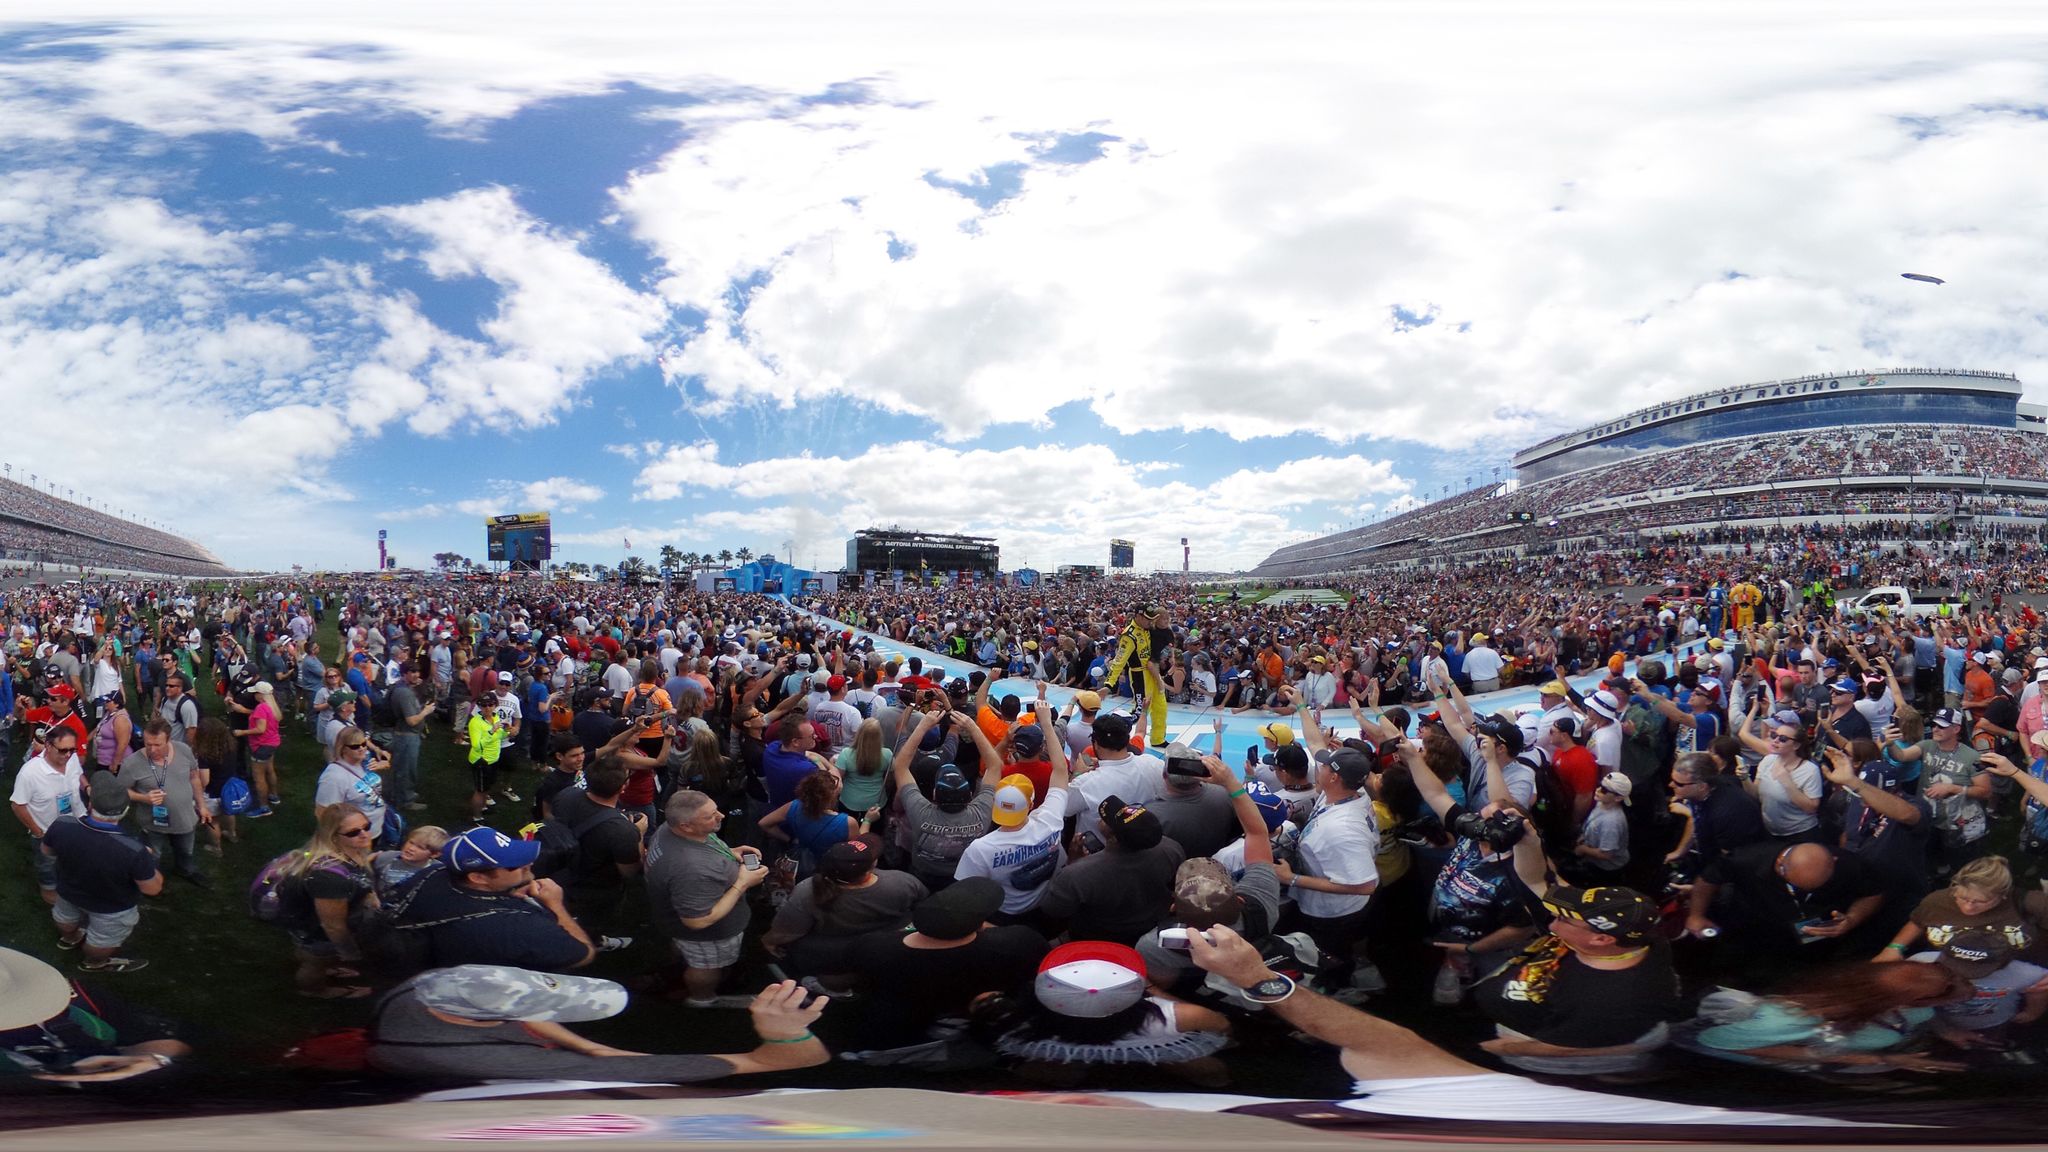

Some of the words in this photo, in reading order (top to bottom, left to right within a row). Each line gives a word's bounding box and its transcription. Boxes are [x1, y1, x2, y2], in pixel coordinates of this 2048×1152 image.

[1586, 421, 1631, 440] WORLD
[1641, 400, 1706, 423] CENTER
[1720, 392, 1743, 405] OF
[1757, 380, 1840, 399] RACING
[1246, 781, 1271, 796] 24
[1587, 915, 1618, 930] 20
[1950, 945, 1988, 957] TOYOTA
[1507, 980, 1530, 1001] 20
